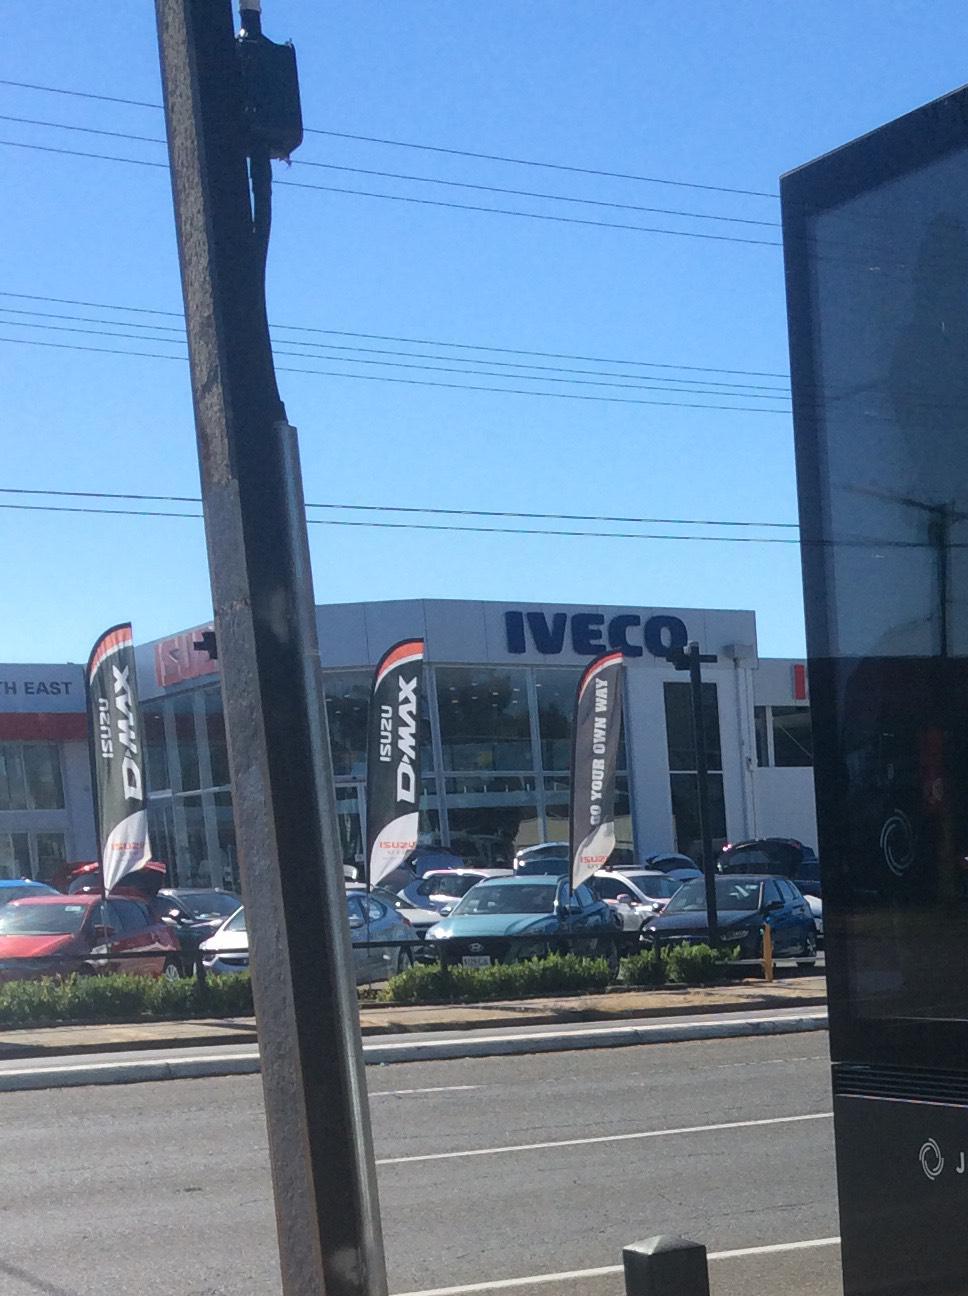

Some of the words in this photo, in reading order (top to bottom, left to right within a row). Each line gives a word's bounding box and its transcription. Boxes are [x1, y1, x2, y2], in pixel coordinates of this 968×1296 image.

[505, 611, 688, 658] IVECO
[24, 681, 73, 695] EAST
[595, 678, 609, 713] WAY
[98, 698, 114, 759] ISUZU
[379, 705, 393, 762] ISUZU
[593, 717, 607, 754] OWN
[590, 758, 605, 803] YOUR
